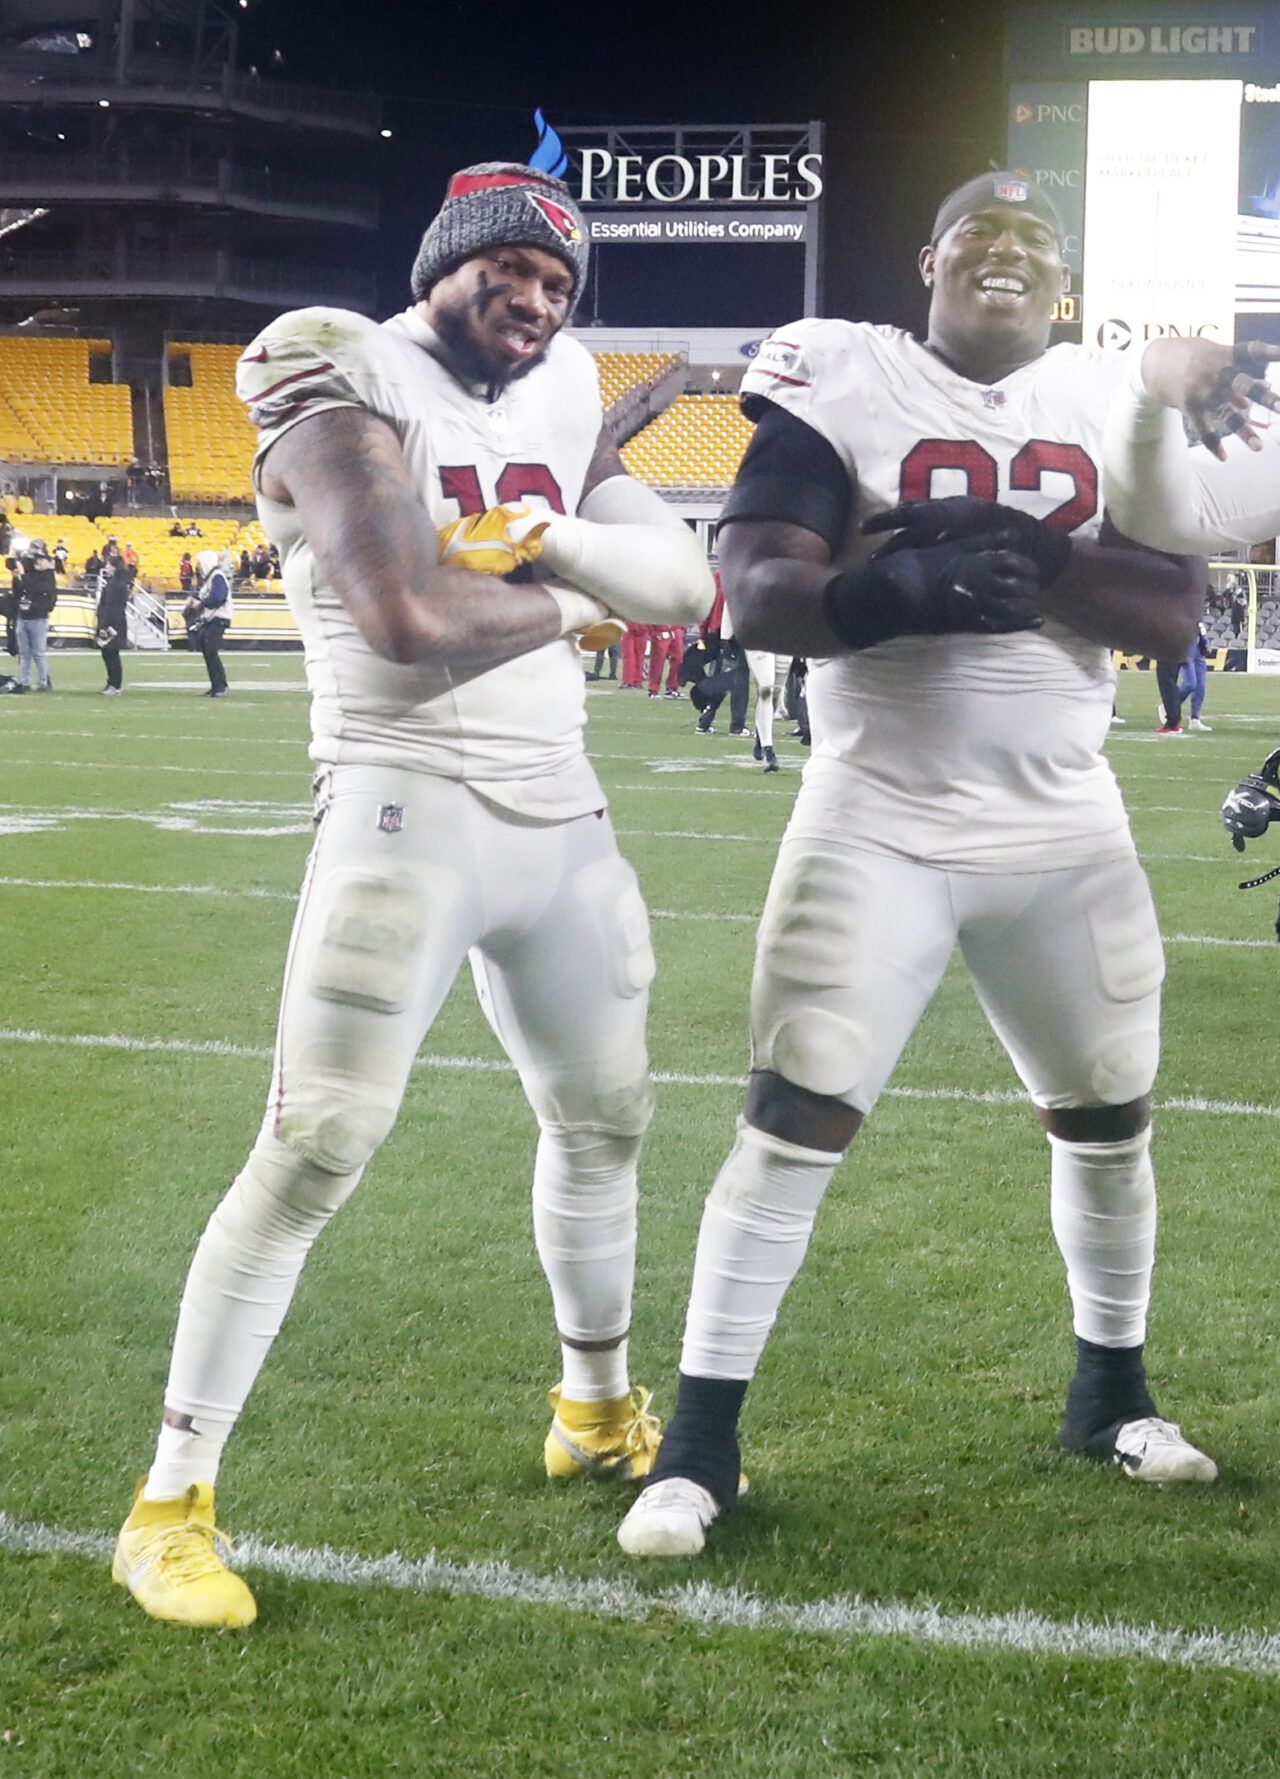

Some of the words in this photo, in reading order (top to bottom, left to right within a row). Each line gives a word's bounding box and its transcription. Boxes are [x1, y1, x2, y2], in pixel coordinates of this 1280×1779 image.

[1070, 26, 1145, 54] BUD
[1150, 26, 1256, 53] LIGHT
[1036, 104, 1082, 122] PNC
[578, 147, 824, 202] PEOPLES
[1034, 169, 1080, 188] PNC
[591, 221, 661, 238] Essential
[665, 221, 725, 238] Utilities
[728, 220, 804, 240] Company
